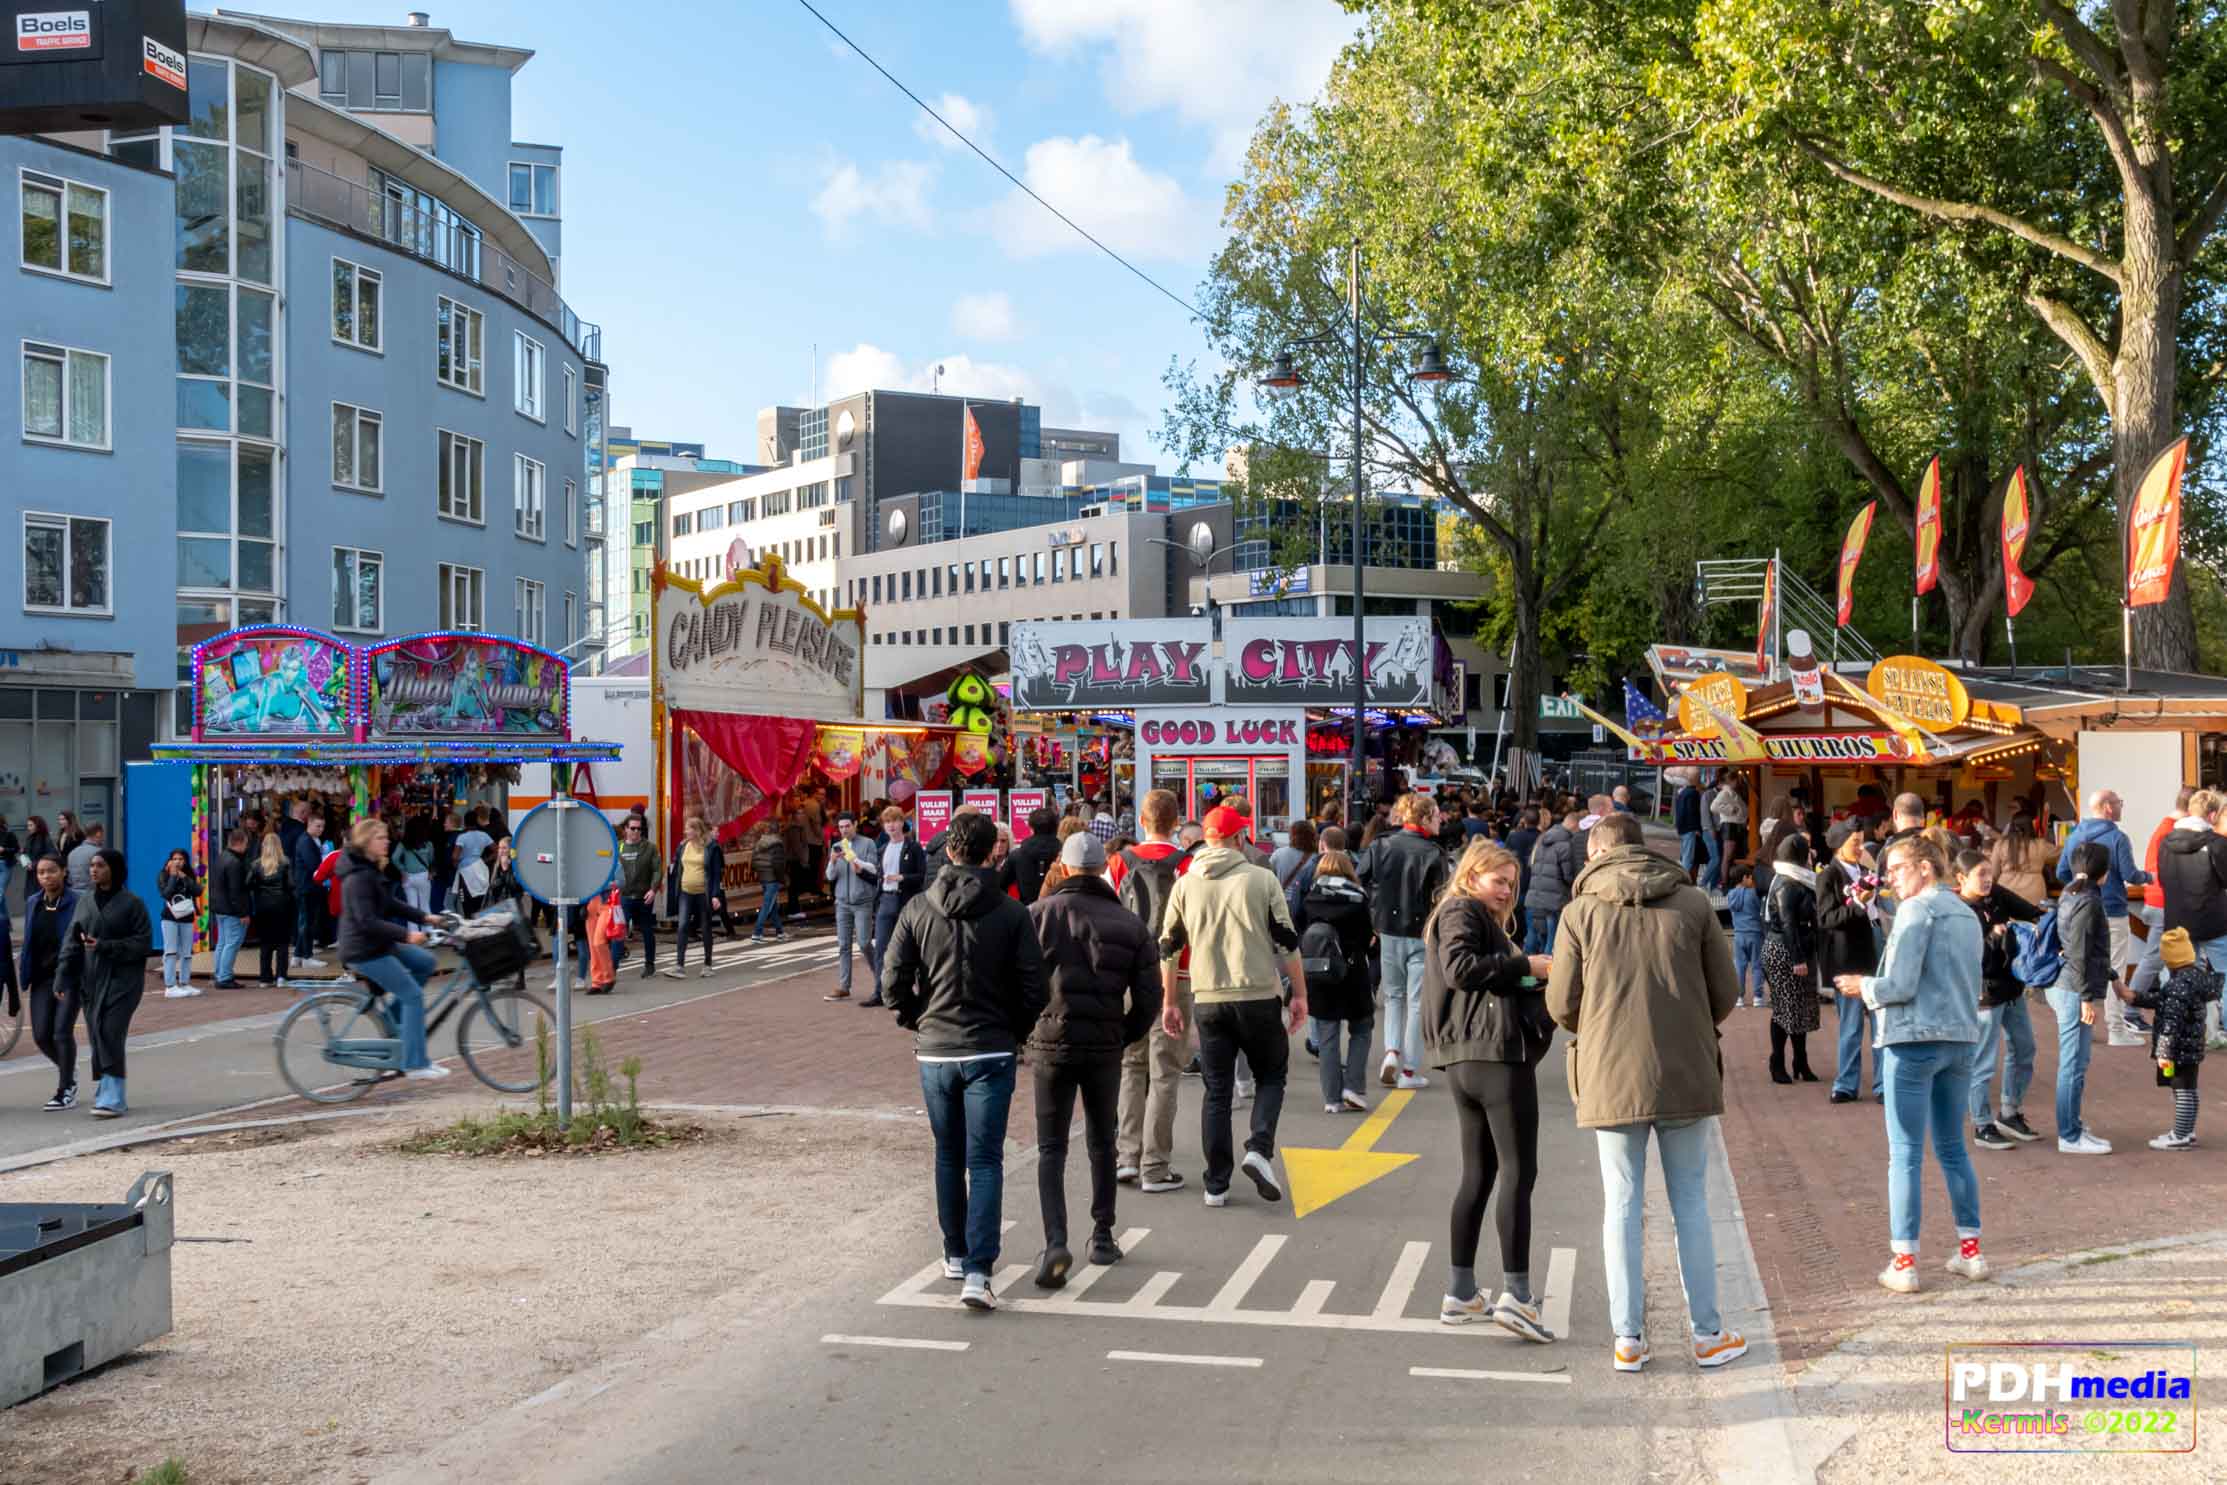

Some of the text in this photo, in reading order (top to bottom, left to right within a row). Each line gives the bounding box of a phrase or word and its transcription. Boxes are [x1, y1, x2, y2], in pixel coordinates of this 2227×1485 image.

[22, 16, 86, 33] Boels
[147, 42, 184, 73] Boels
[669, 600, 855, 687] CANDY PLEASURE
[1050, 638, 1389, 690] PLAY CITY
[1141, 720, 1215, 745] GOOD
[1224, 720, 1298, 745] LUCK
[1673, 736, 1877, 759] SPAA CHURROS
[920, 801, 948, 809] VULLEN
